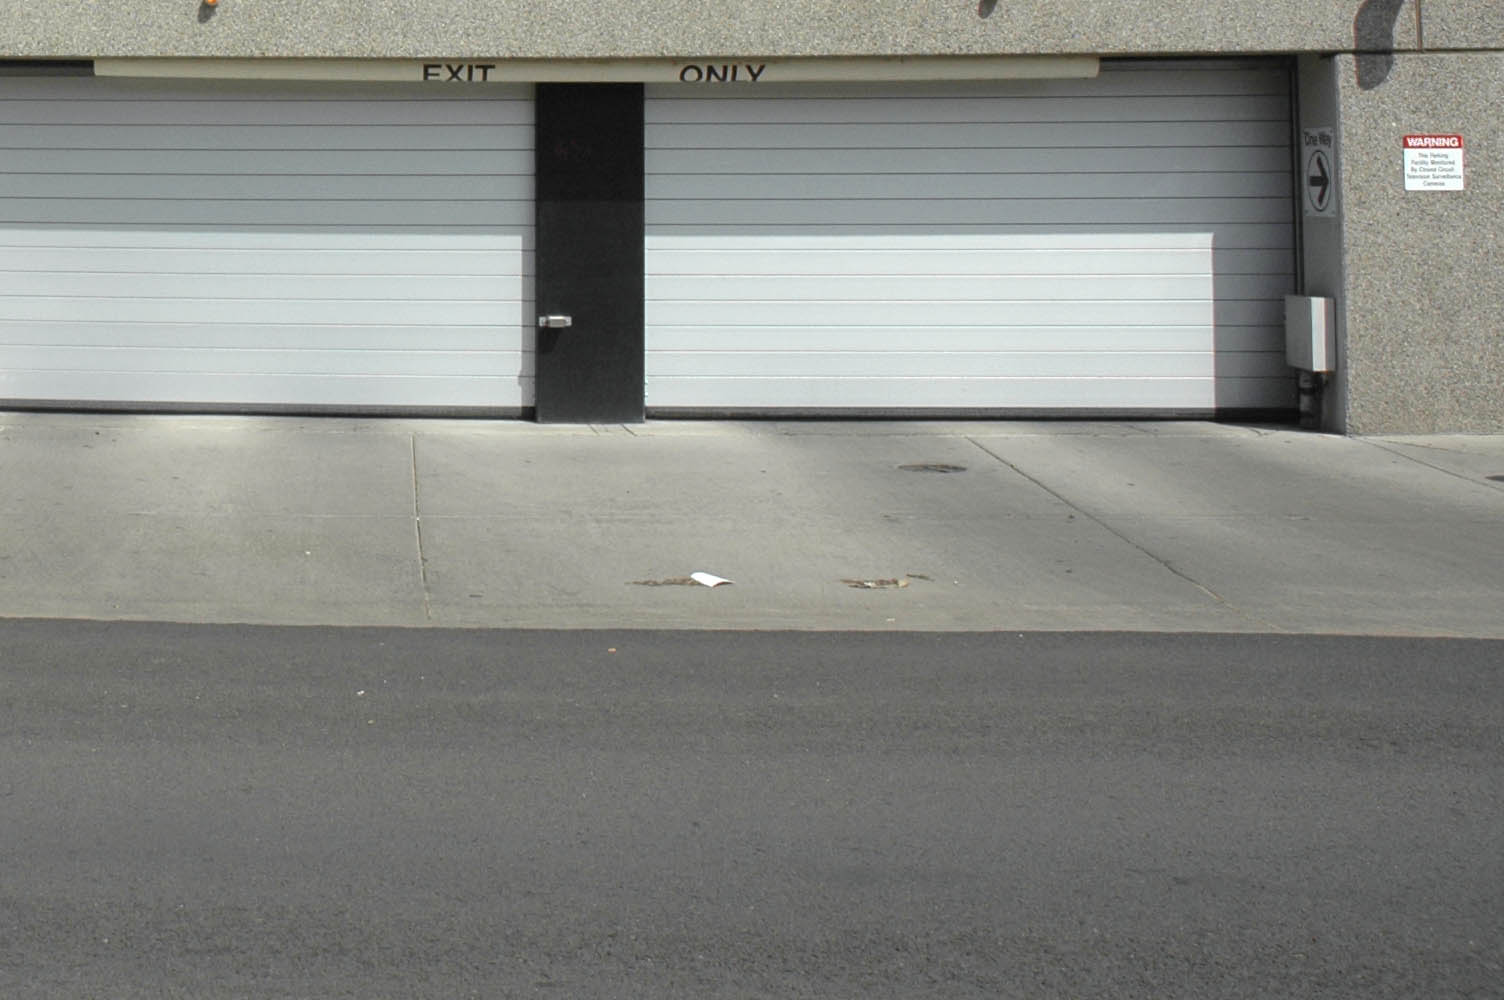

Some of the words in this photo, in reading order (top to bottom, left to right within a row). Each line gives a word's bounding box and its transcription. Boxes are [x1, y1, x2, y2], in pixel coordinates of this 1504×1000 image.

[422, 63, 496, 82] EXIT
[679, 64, 766, 82] ONLY
[1304, 132, 1318, 146] One
[1319, 132, 1332, 148] Way
[1407, 136, 1459, 147] WARNING
